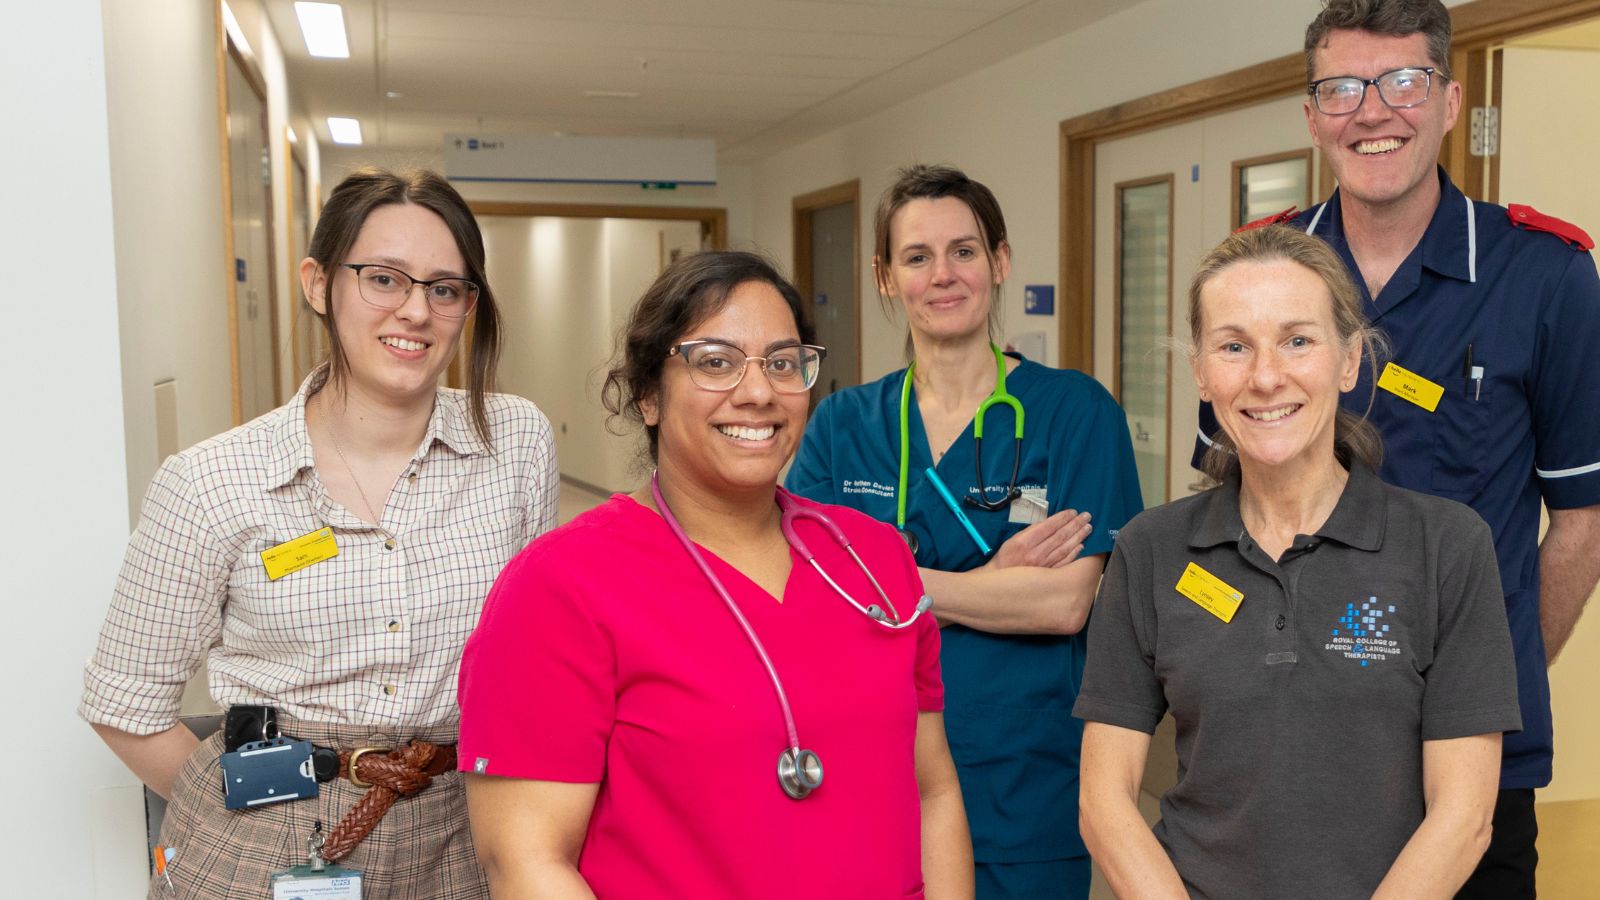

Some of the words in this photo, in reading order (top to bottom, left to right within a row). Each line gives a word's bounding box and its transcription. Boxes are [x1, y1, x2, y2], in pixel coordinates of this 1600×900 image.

[1403, 384, 1416, 394] Mark
[873, 482, 895, 491] Davies
[861, 487, 895, 498] Consultant
[1365, 646, 1401, 654] LANGUAGE
[1344, 652, 1386, 660] THERAPISTS
